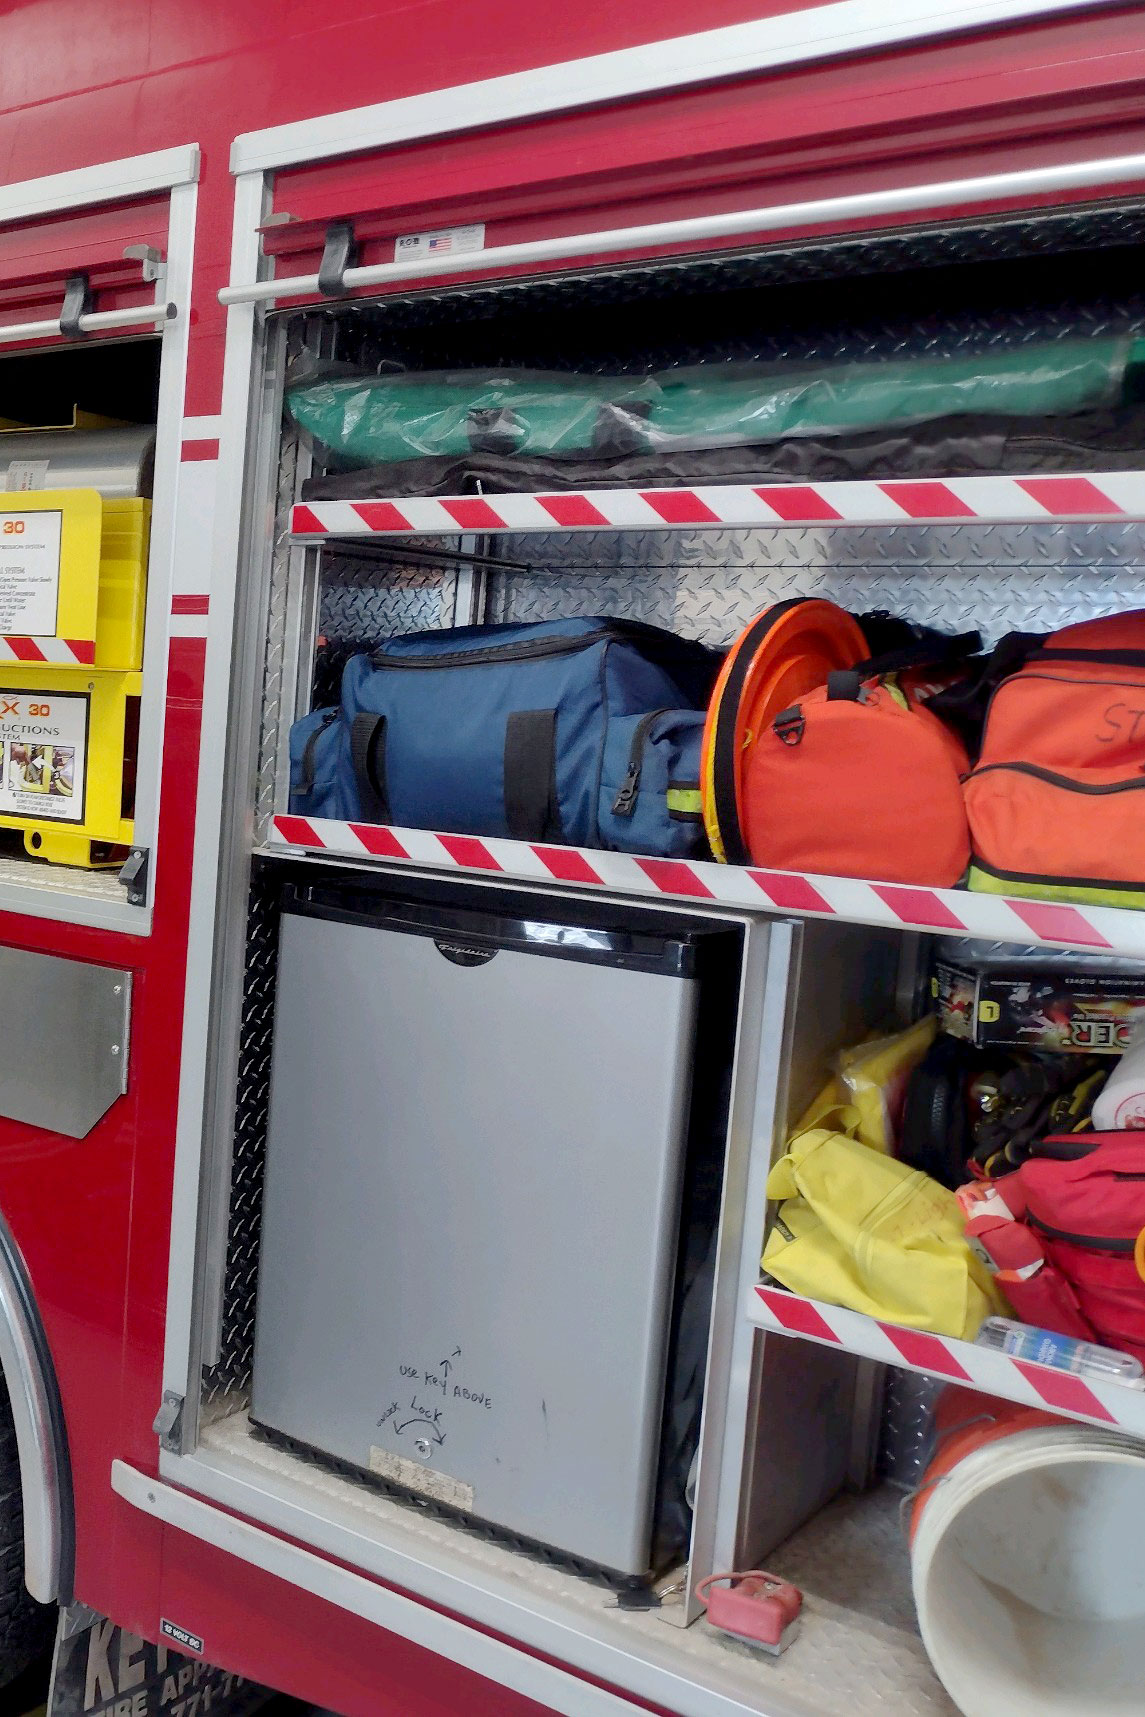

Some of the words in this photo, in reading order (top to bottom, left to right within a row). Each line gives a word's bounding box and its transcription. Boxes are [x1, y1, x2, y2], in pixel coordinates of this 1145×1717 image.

[2, 520, 26, 535] 30
[28, 703, 50, 717] 30
[453, 1385, 492, 1410] ABOVE
